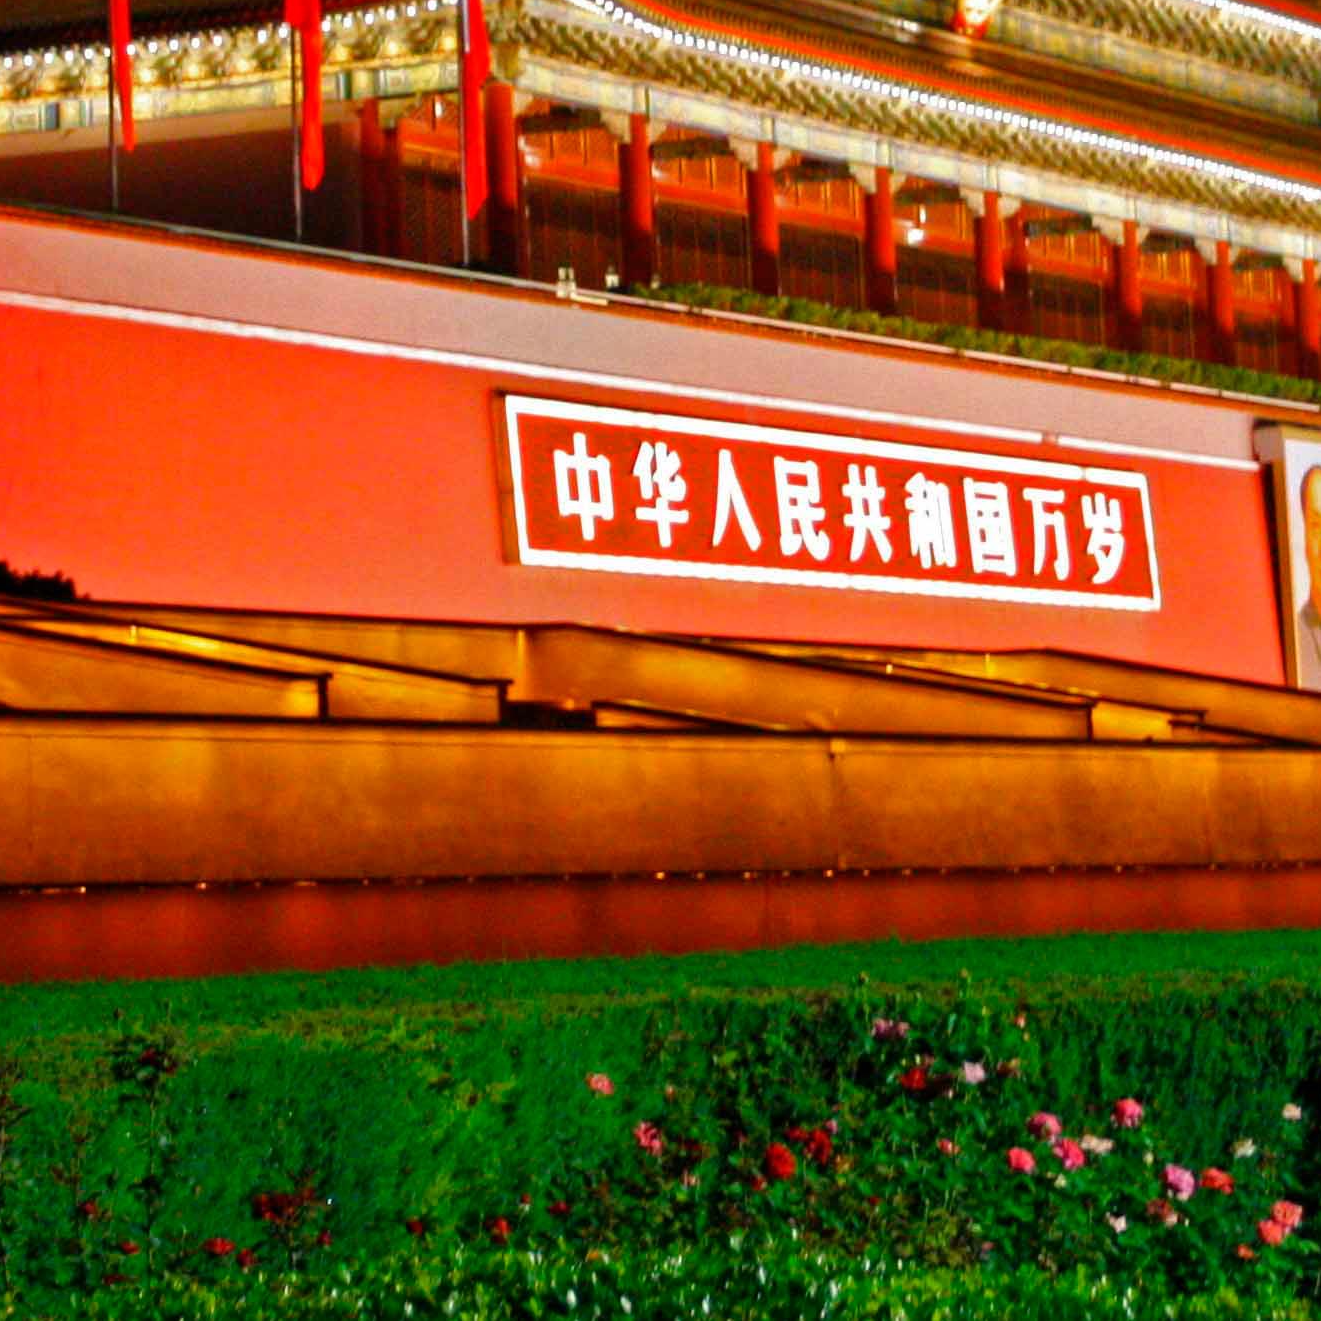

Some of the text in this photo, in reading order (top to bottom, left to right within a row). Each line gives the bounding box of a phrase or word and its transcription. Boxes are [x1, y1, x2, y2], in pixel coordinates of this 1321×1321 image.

[552, 431, 1125, 584] 中华人民共和国万岁
